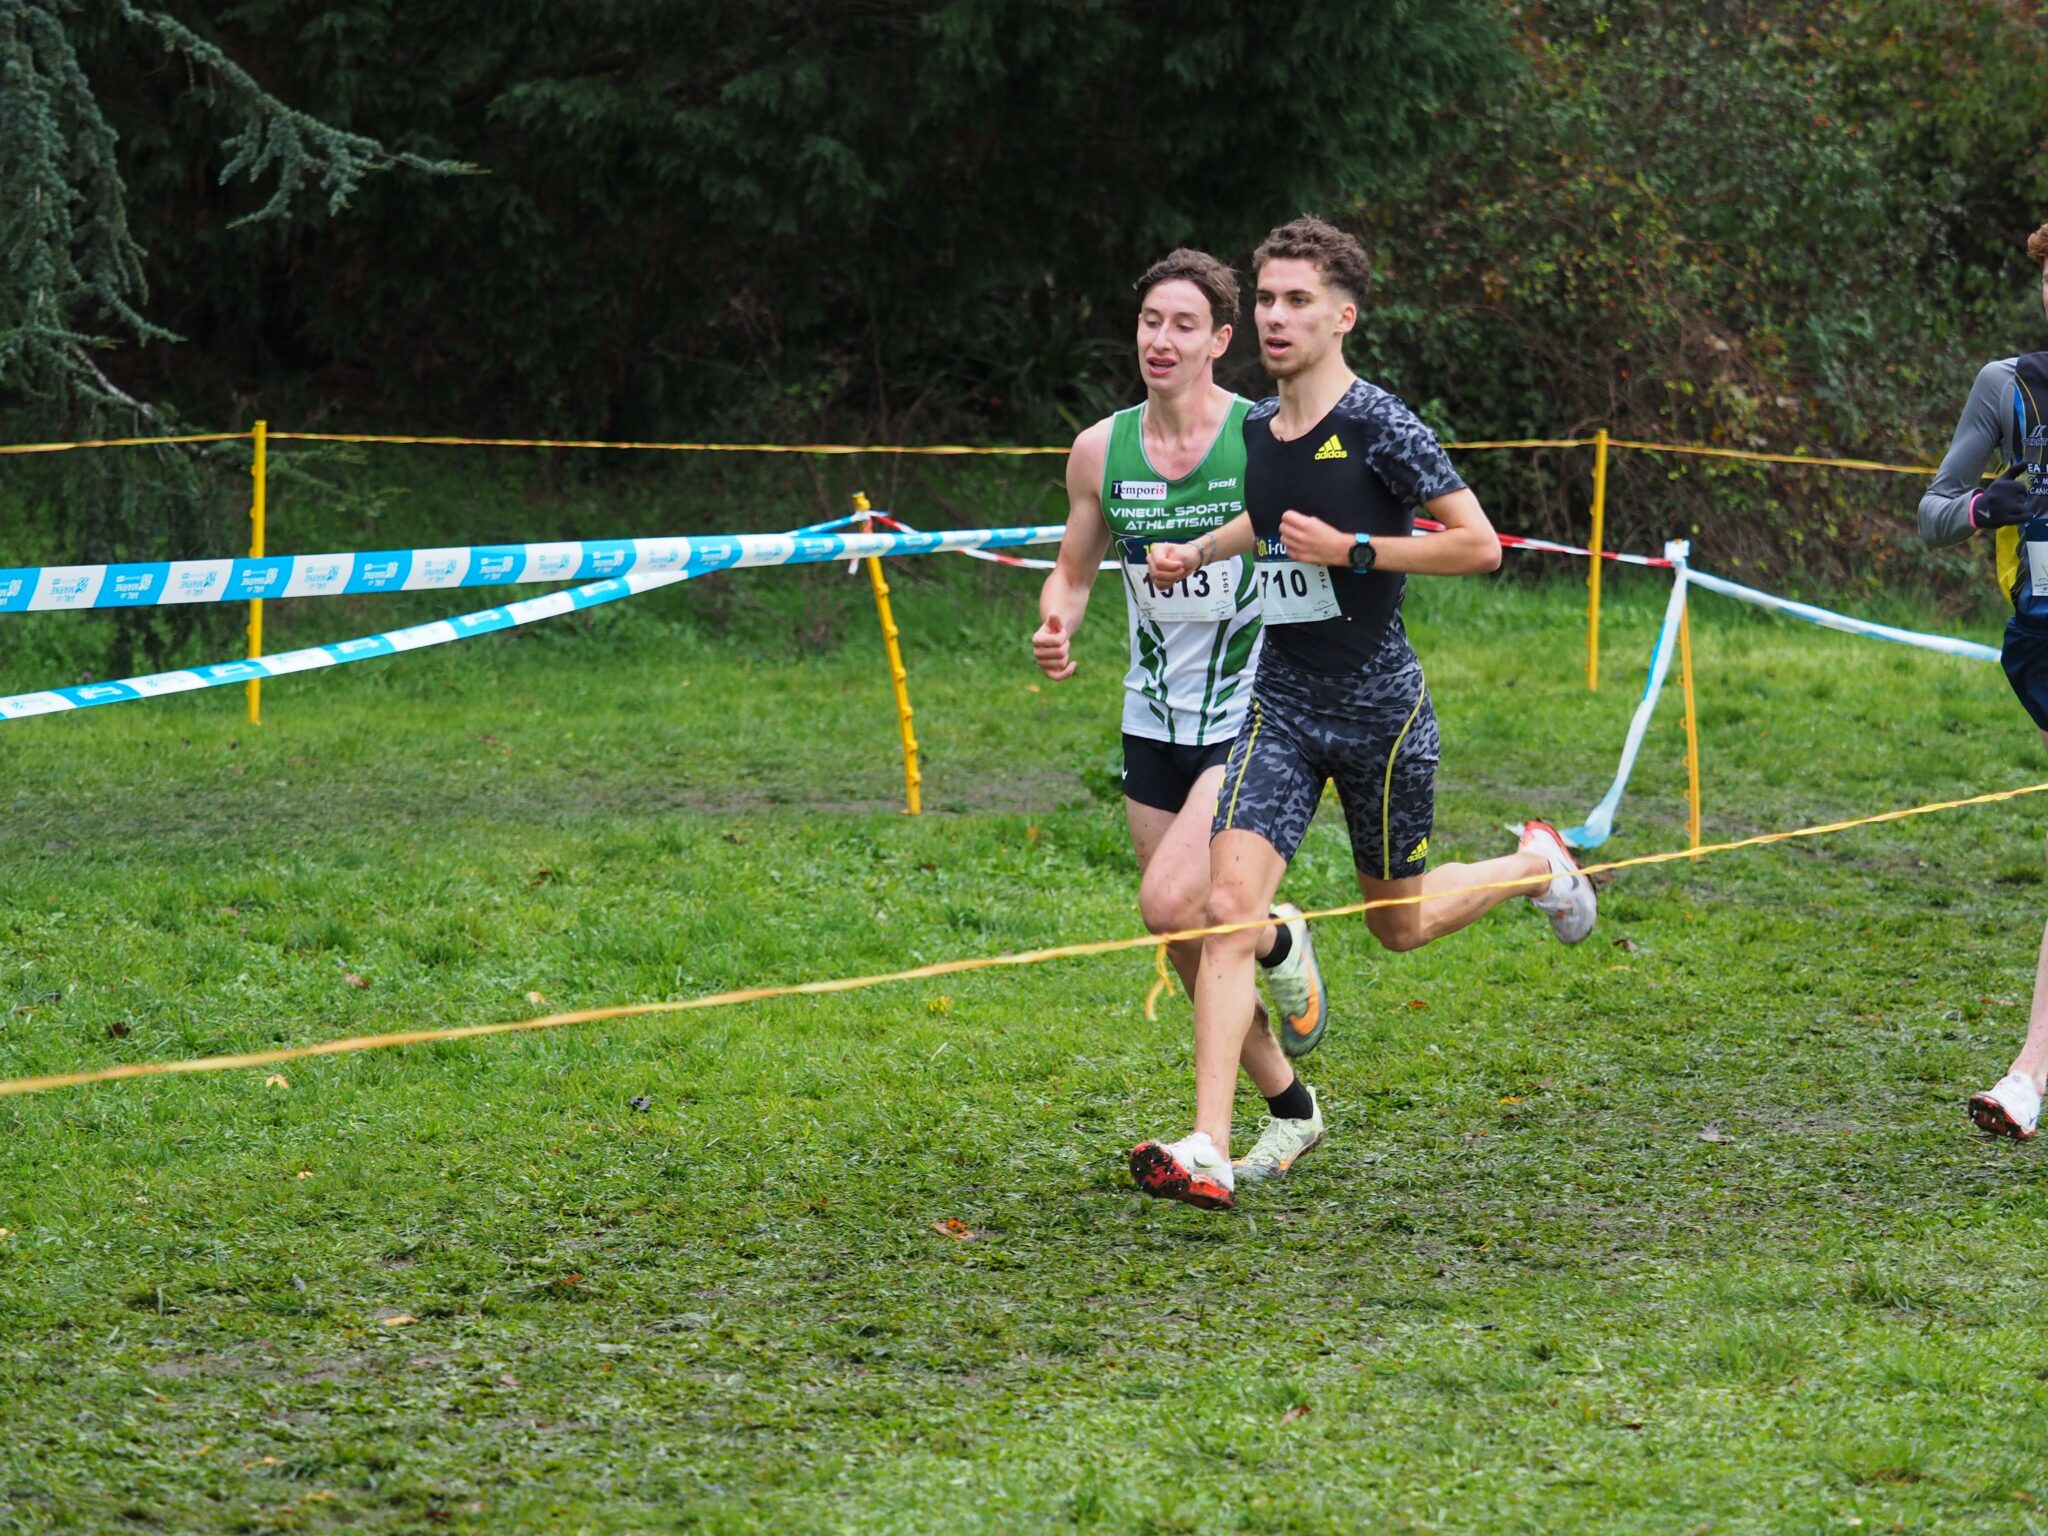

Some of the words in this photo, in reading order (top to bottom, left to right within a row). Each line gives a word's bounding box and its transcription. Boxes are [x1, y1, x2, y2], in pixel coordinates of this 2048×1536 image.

[1314, 449, 1348, 461] adidas
[1113, 482, 1165, 498] Temporis
[1110, 507, 1170, 518] VINEUIL
[1175, 501, 1242, 516] SPORTS
[1125, 516, 1224, 531] ATHLETISME
[1268, 539, 1287, 555] i-ru
[1221, 571, 1230, 593] 1913
[1261, 569, 1308, 599] 710
